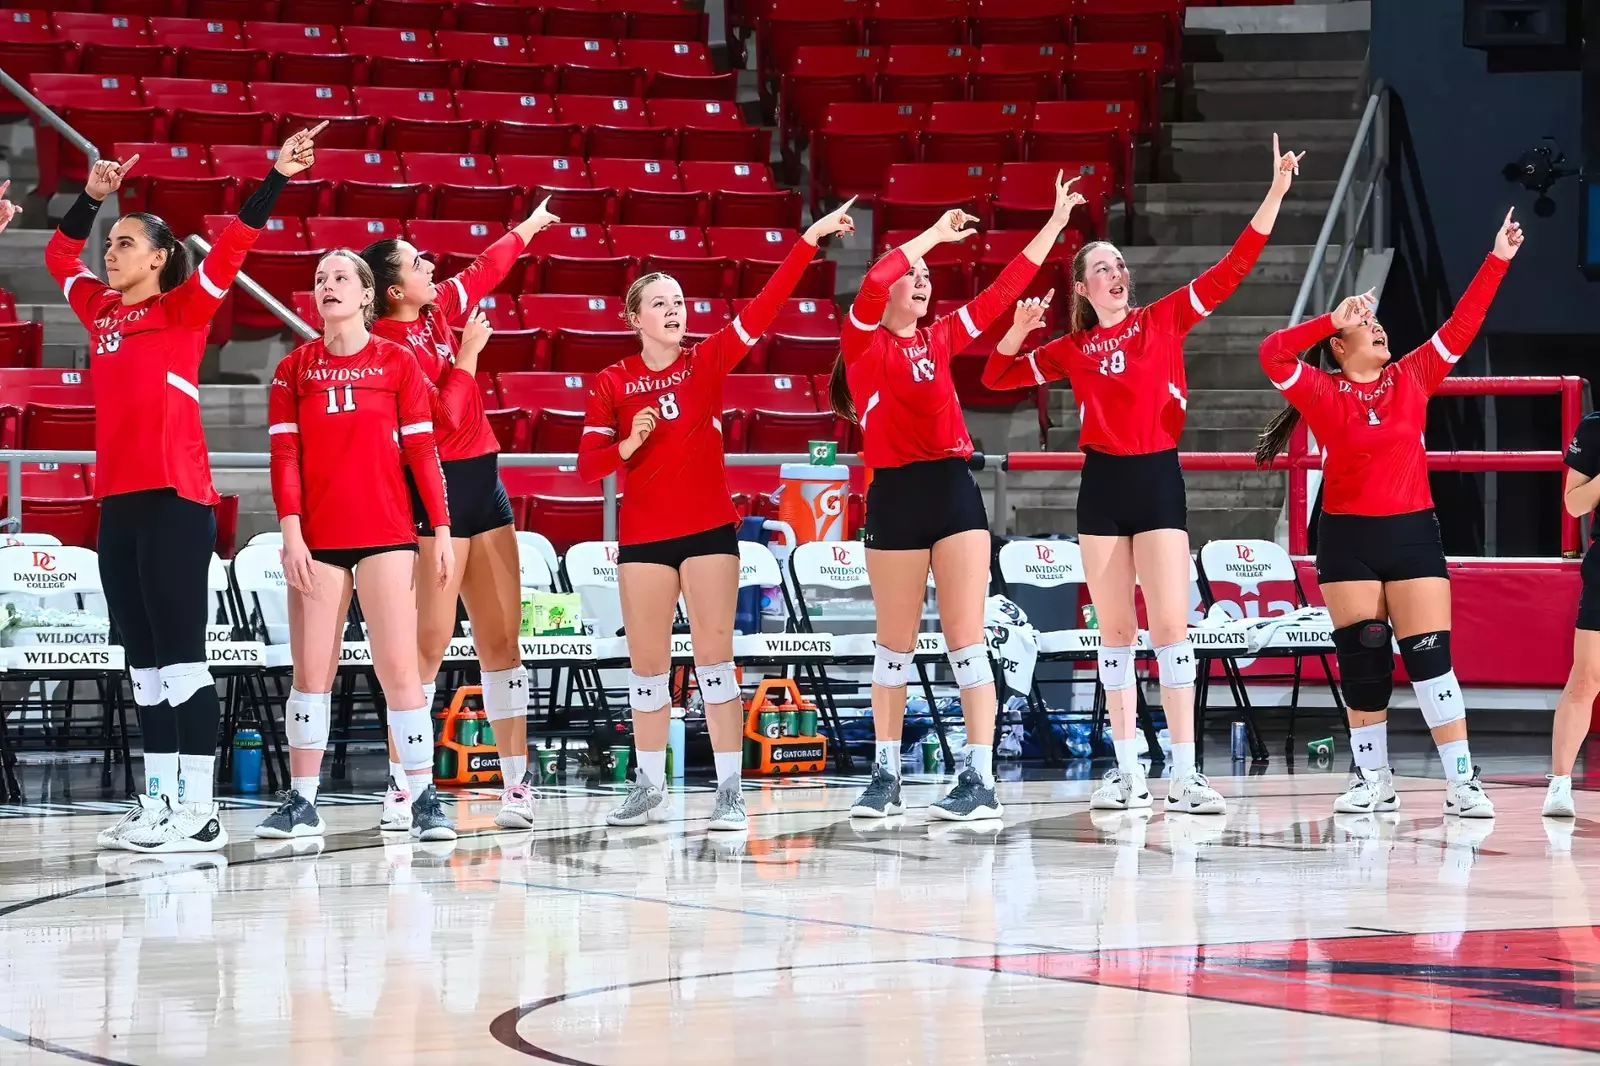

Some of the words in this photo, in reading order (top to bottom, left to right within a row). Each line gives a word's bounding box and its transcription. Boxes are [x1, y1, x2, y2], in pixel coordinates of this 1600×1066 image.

[325, 383, 356, 414] 11
[658, 392, 680, 420] 8
[820, 489, 841, 516] G
[832, 546, 851, 565] DC
[1036, 545, 1055, 563] DC
[1236, 545, 1255, 562] DC
[32, 551, 56, 571] DC
[1025, 565, 1072, 573] DAVIDSON
[1226, 564, 1271, 572] DAVIDSON
[13, 572, 77, 582] DAVIDSON
[36, 633, 106, 644] WILDCATS
[522, 643, 592, 655] WILDCATS
[766, 640, 831, 651] WILDCATS
[24, 652, 109, 664] WILDCATS
[773, 748, 783, 761] G
[783, 749, 822, 758] GATORADE
[470, 757, 481, 769] G
